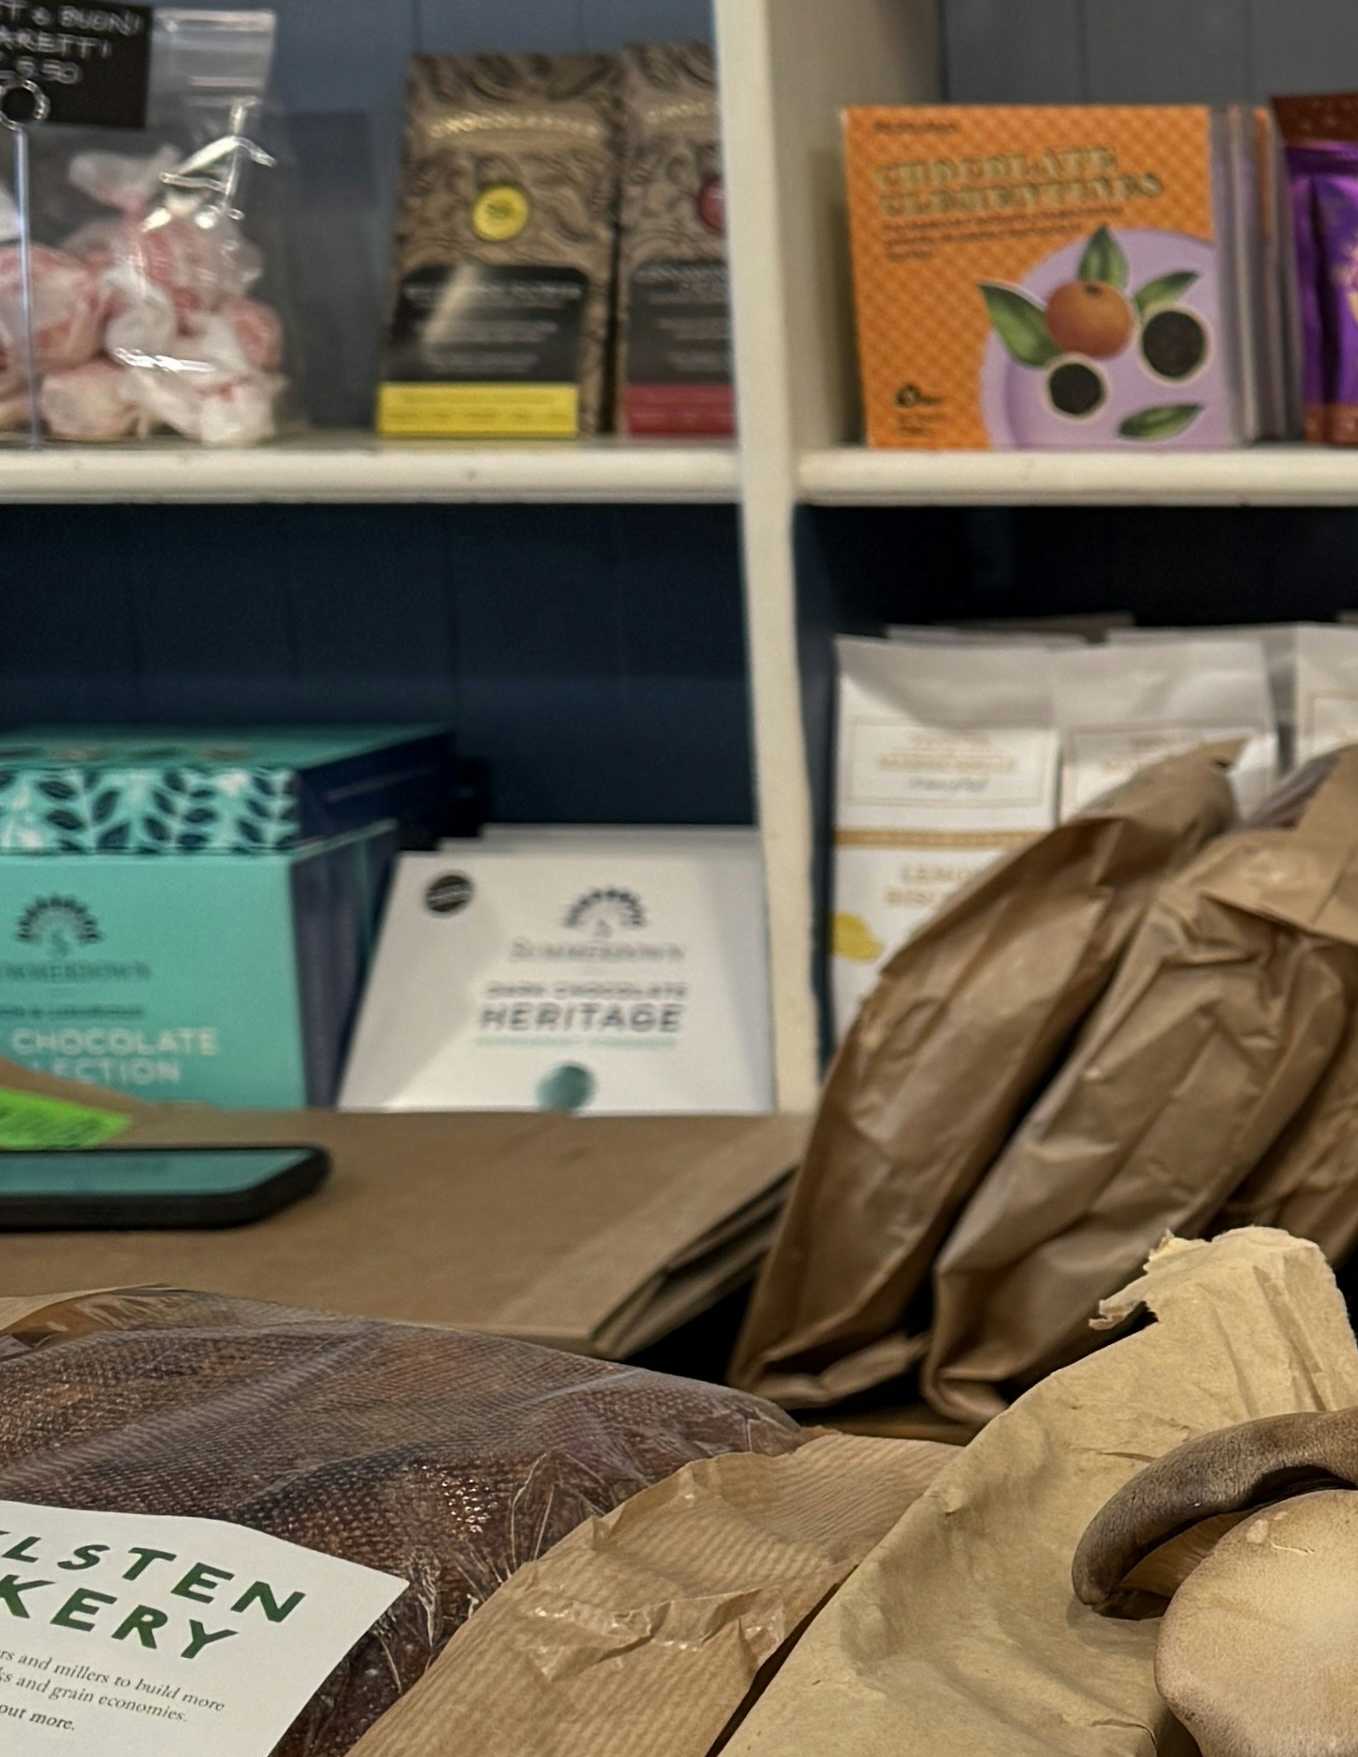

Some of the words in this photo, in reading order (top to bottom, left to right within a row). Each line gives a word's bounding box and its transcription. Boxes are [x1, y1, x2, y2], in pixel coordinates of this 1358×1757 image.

[11, 1026, 219, 1057] CHOCOLATE
[478, 1001, 684, 1034] HERITAGE
[0, 1530, 306, 1623] LSTEN
[0, 1574, 239, 1659] KERY
[16, 1676, 51, 1694] and
[48, 1685, 94, 1703] grain
[98, 1695, 189, 1724] economies.
[18, 1654, 52, 1672] and
[53, 1664, 110, 1684] millers
[114, 1676, 131, 1688] to
[135, 1678, 181, 1701] build
[181, 1692, 225, 1713] more
[29, 1711, 76, 1732] more.
